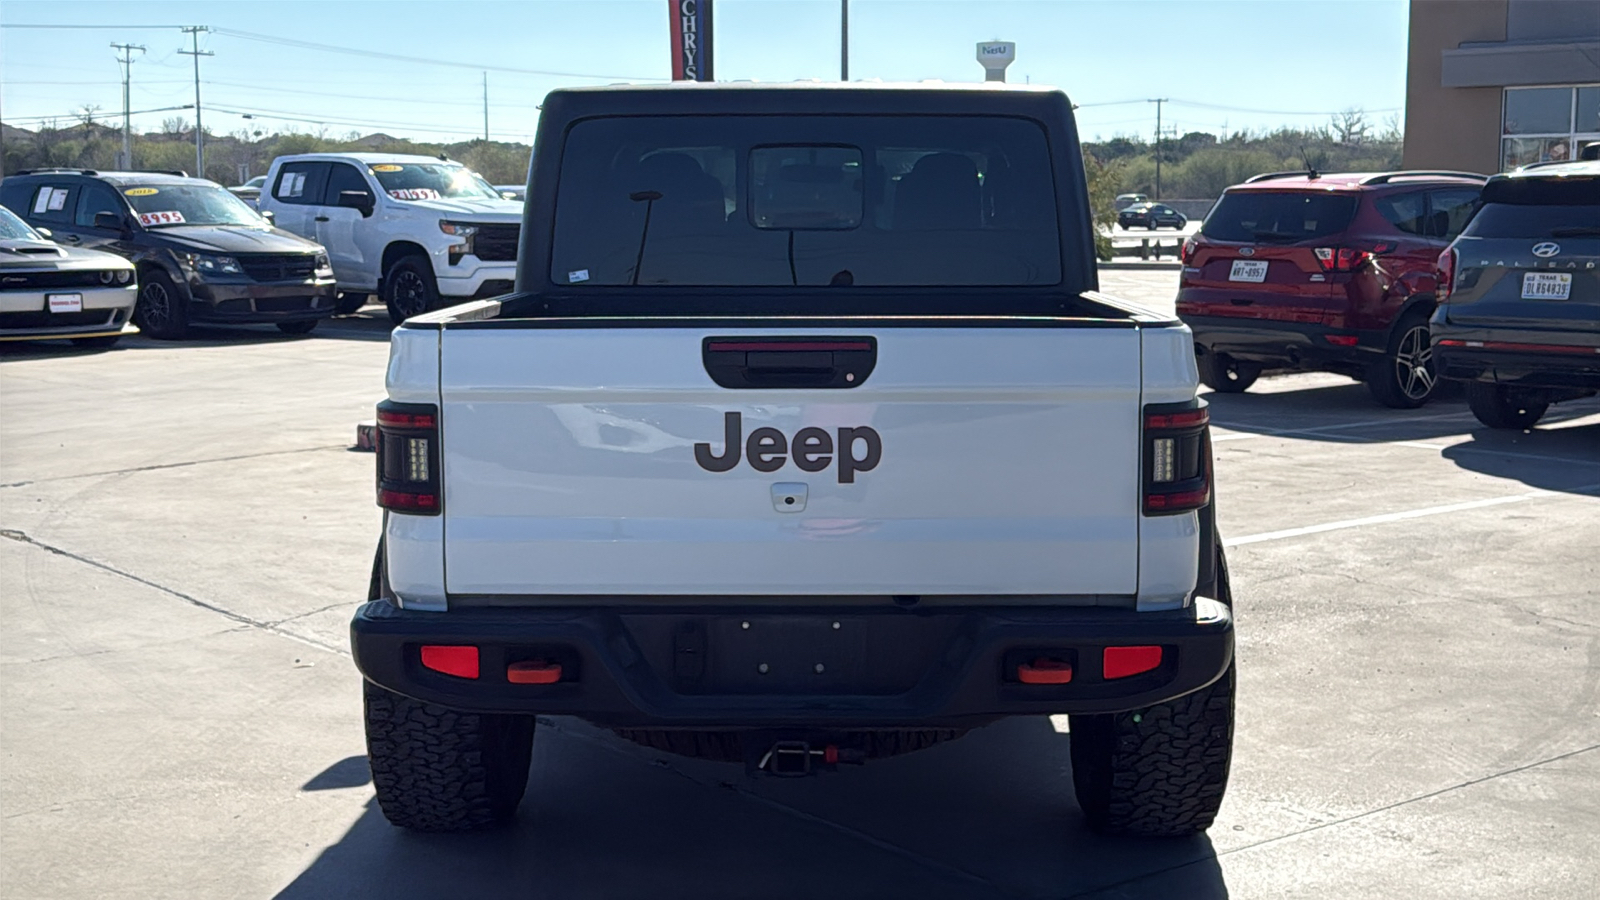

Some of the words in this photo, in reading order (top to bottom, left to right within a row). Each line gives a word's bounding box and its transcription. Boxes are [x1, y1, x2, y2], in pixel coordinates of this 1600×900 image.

[682, 0, 697, 80] CHRYS
[982, 46, 1006, 54] NBU
[140, 211, 182, 224] 8995
[694, 412, 882, 484] Jeep
